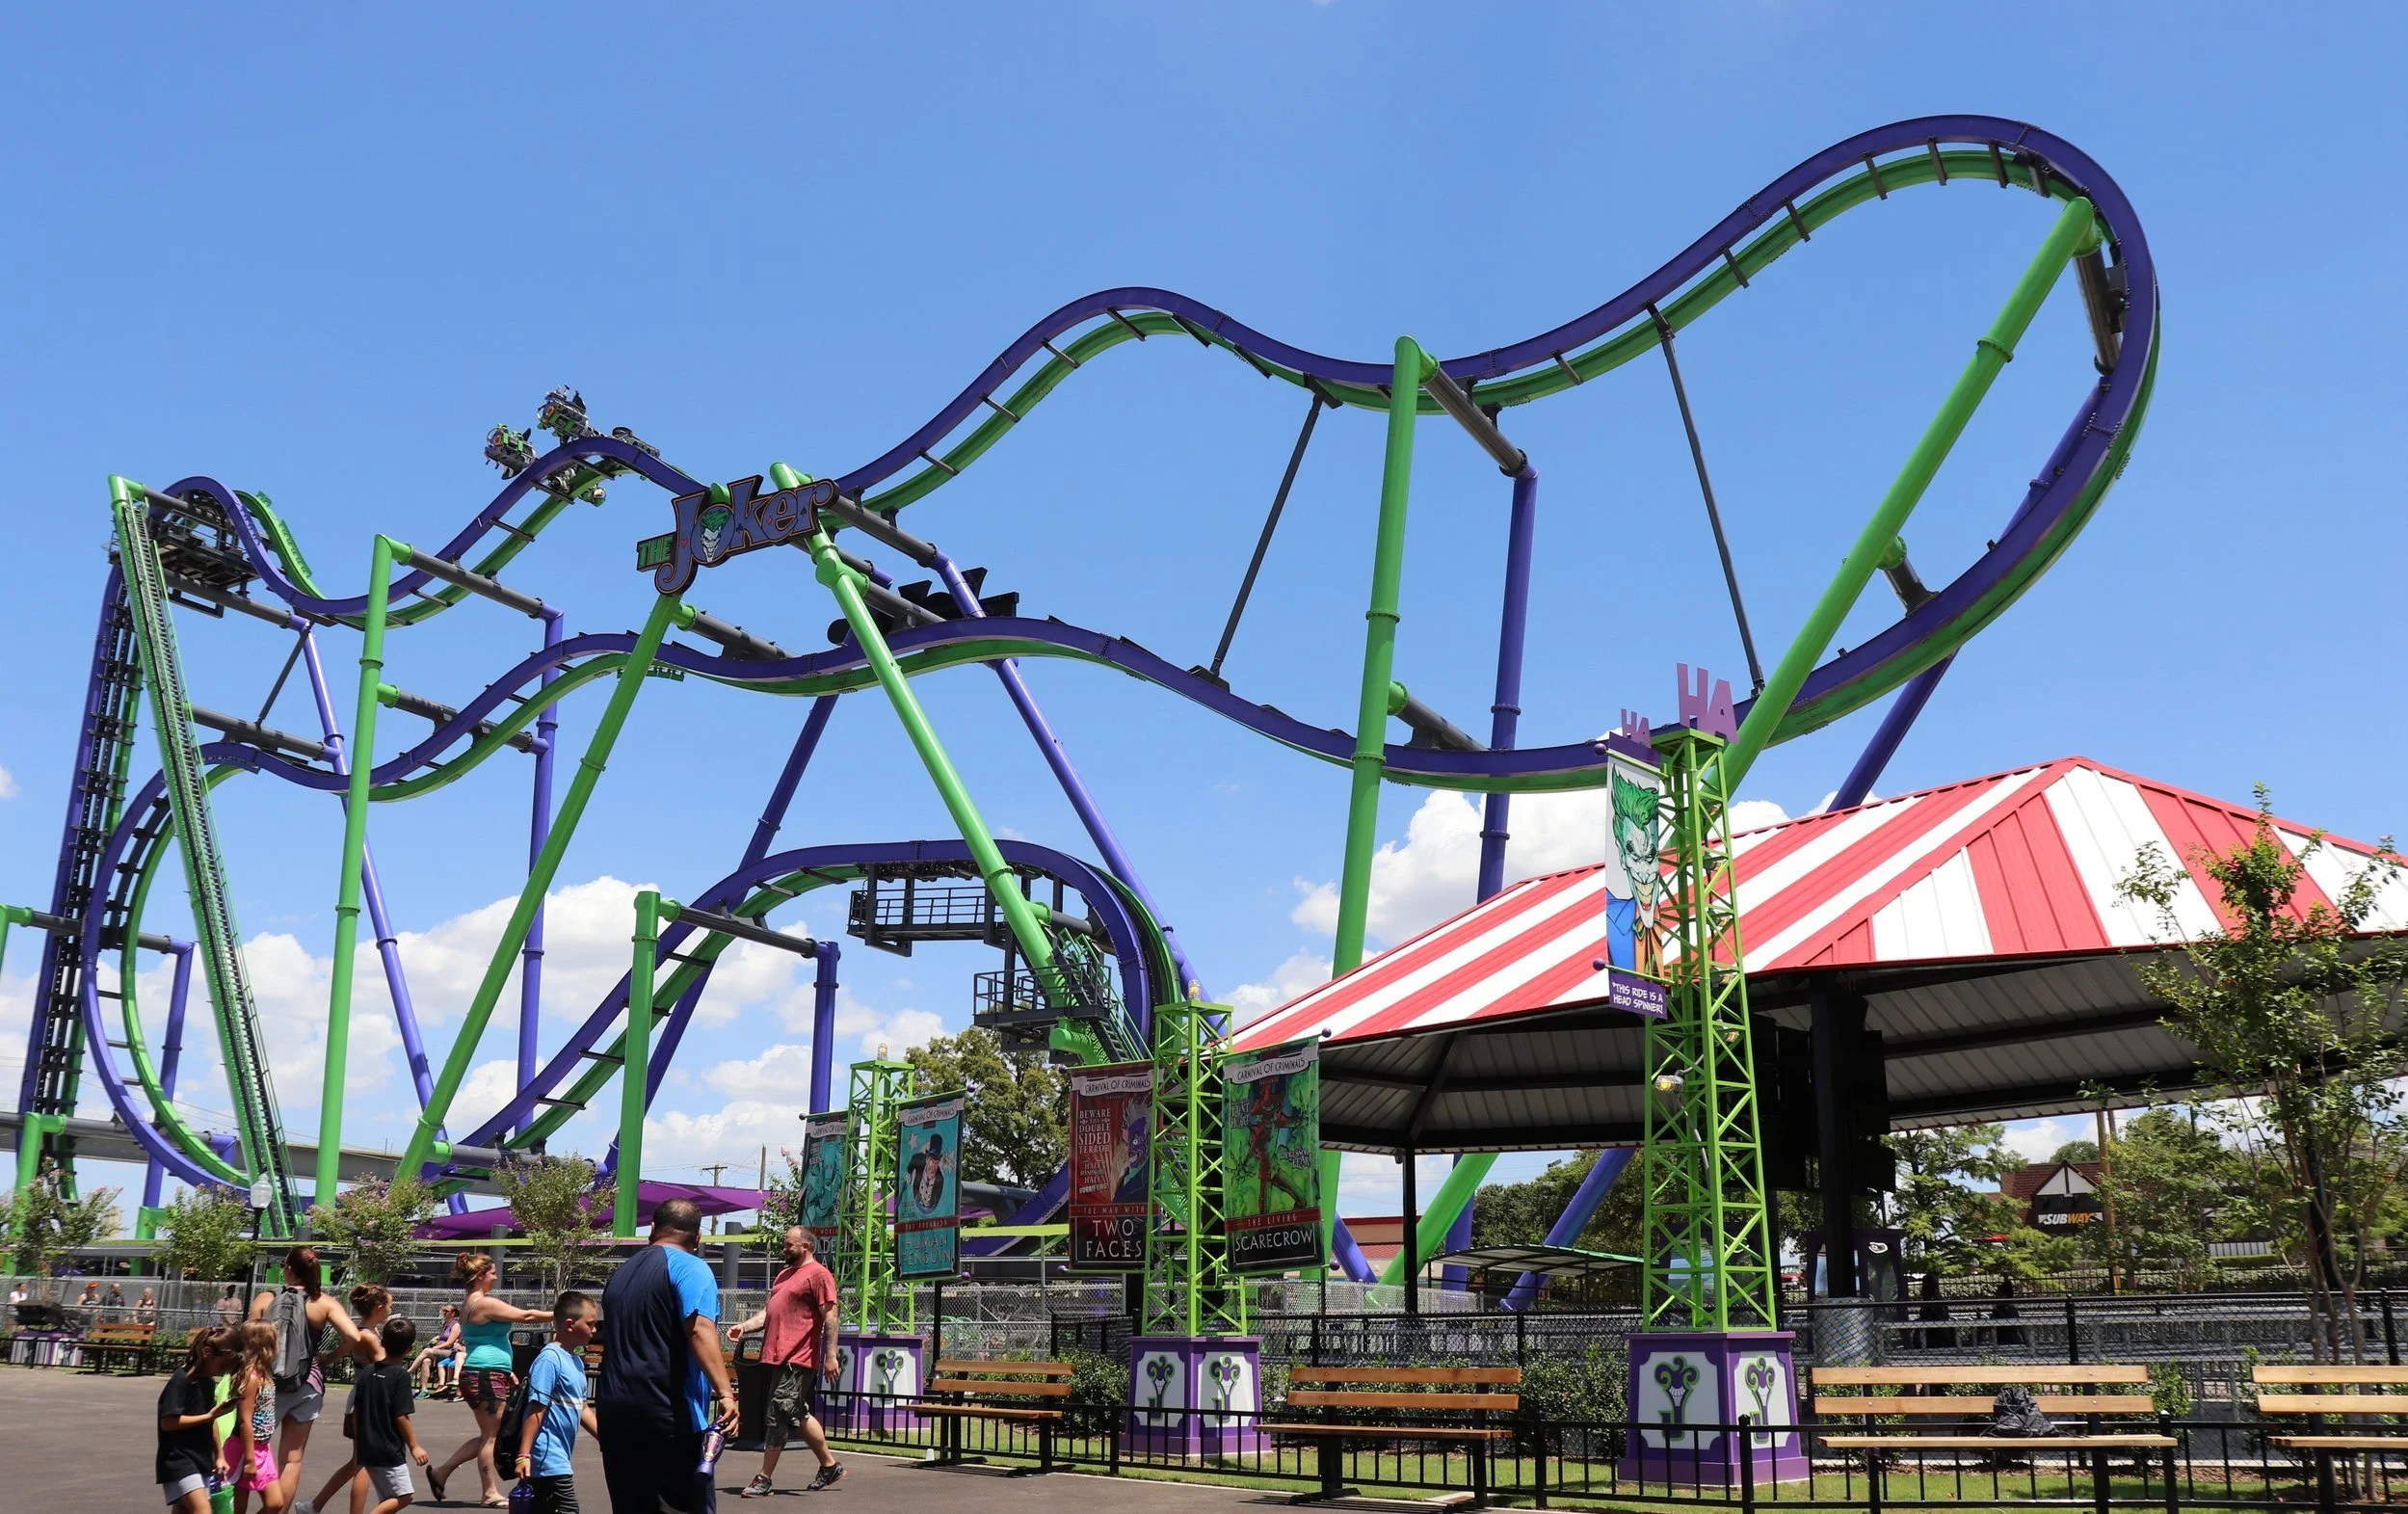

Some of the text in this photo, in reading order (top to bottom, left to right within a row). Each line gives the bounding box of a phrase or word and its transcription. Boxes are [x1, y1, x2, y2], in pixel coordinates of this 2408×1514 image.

[638, 536, 673, 570] THE
[1677, 662, 1739, 746] HA
[1621, 708, 1651, 749] HA
[1613, 993, 1663, 1014] HEAD SPINNER!
[1631, 987, 1648, 999] RIDE
[1649, 991, 1656, 1001] IS
[1657, 993, 1664, 1003] A
[1236, 1057, 1306, 1080] CARNIVAL OF CRIMINALS
[1084, 1078, 1151, 1095] CARNIVAL OF CRIMINALS
[1079, 1108, 1111, 1119] BEWARE
[1079, 1123, 1111, 1133] DOUBLE
[1079, 1131, 1111, 1145] SIDED
[1078, 1144, 1111, 1154] TERROR
[1101, 1206, 1118, 1214] MAN
[2042, 1211, 2096, 1225] SUBWAY
[1093, 1219, 1134, 1236] TWO
[1248, 1213, 1297, 1227] THE LIVING
[904, 1234, 948, 1250] HUMAN
[1086, 1240, 1142, 1258] FACES
[1235, 1229, 1314, 1252] SCARECROW
[902, 1248, 952, 1266] PENGUIN
